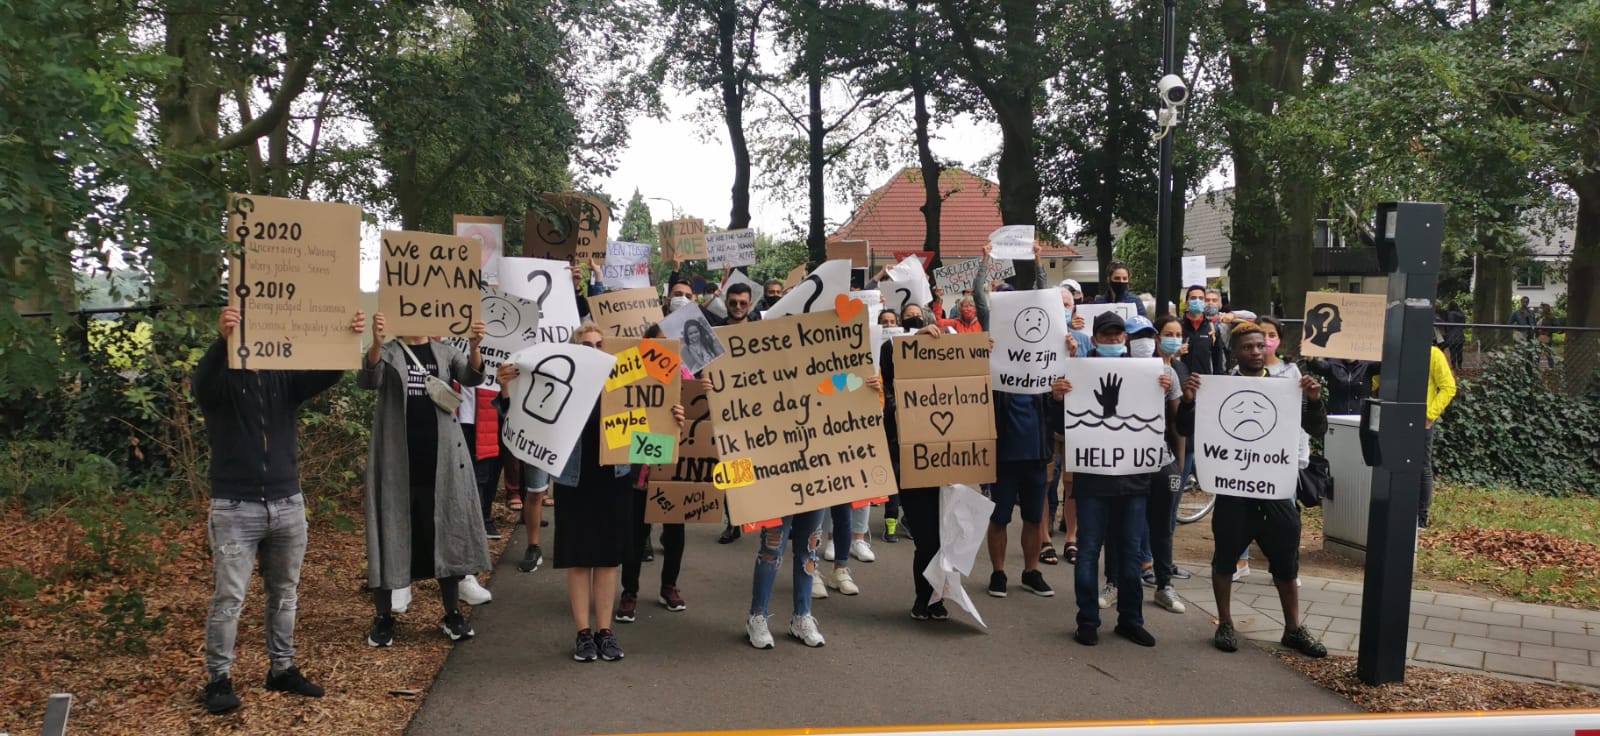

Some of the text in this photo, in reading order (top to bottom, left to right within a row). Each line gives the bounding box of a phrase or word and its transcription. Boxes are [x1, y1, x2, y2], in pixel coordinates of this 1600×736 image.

[254, 222, 302, 240] 2020
[384, 238, 468, 261] We are
[385, 261, 483, 290] HUMAN
[254, 280, 297, 300] 2019
[399, 295, 473, 335] being
[598, 299, 646, 316] Mensen
[254, 341, 293, 358] 2018
[728, 322, 863, 359] Beste koning
[901, 339, 990, 362] Mensen van
[608, 354, 643, 386] wait
[642, 348, 676, 378] NO!
[1007, 348, 1057, 370] We zijn
[708, 351, 874, 394] U ziet uw dochters
[624, 384, 665, 408] IND
[902, 383, 989, 409] Nederland
[604, 413, 647, 435] maybe
[721, 401, 763, 422] elke
[717, 411, 883, 456] Ik heb mijn dochter
[515, 429, 558, 466] future
[635, 434, 663, 459] Yes
[912, 441, 991, 470] Bedankt
[1075, 446, 1164, 469] HELP US!
[1203, 442, 1291, 471] We zijn ook
[714, 443, 877, 485] al 18 maanden niet
[790, 472, 856, 506] gezien
[1214, 474, 1277, 496] mensen
[683, 490, 705, 506] NO!
